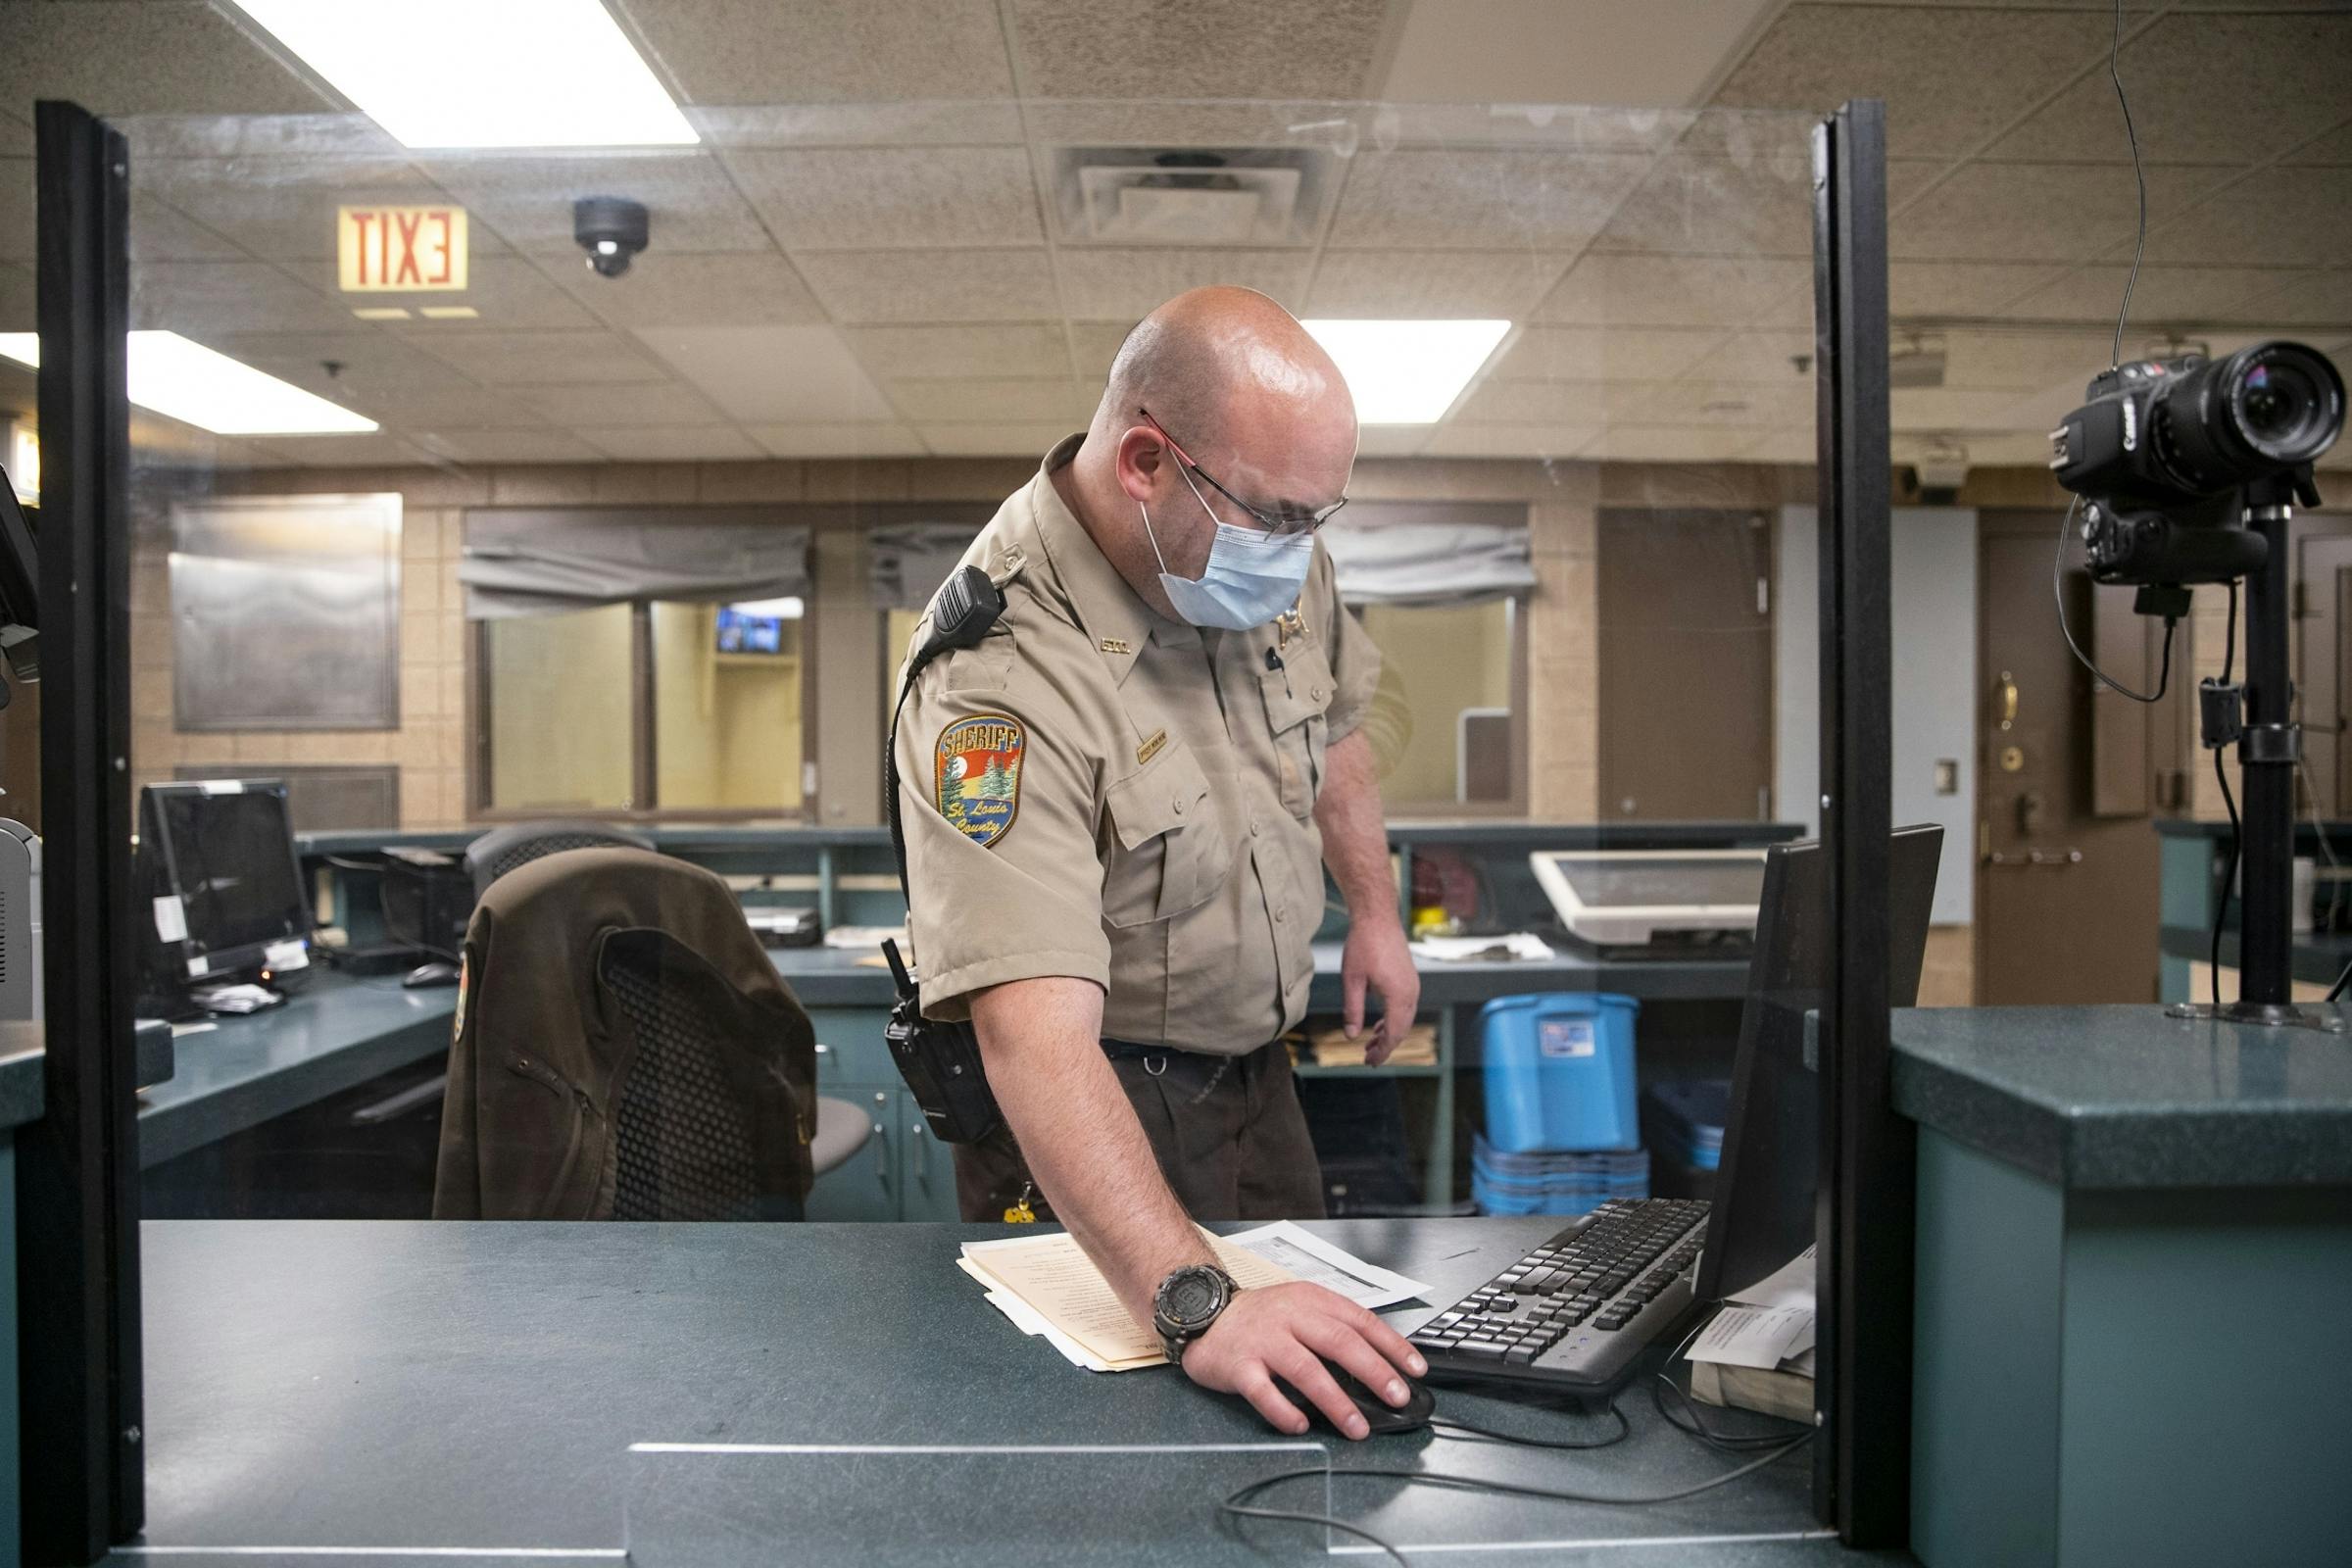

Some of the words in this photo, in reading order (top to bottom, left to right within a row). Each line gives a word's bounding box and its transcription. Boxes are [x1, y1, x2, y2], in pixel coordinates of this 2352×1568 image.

[943, 723, 1018, 759] SHERIFF
[969, 800, 1008, 815] Louis
[956, 817, 1000, 836] County
